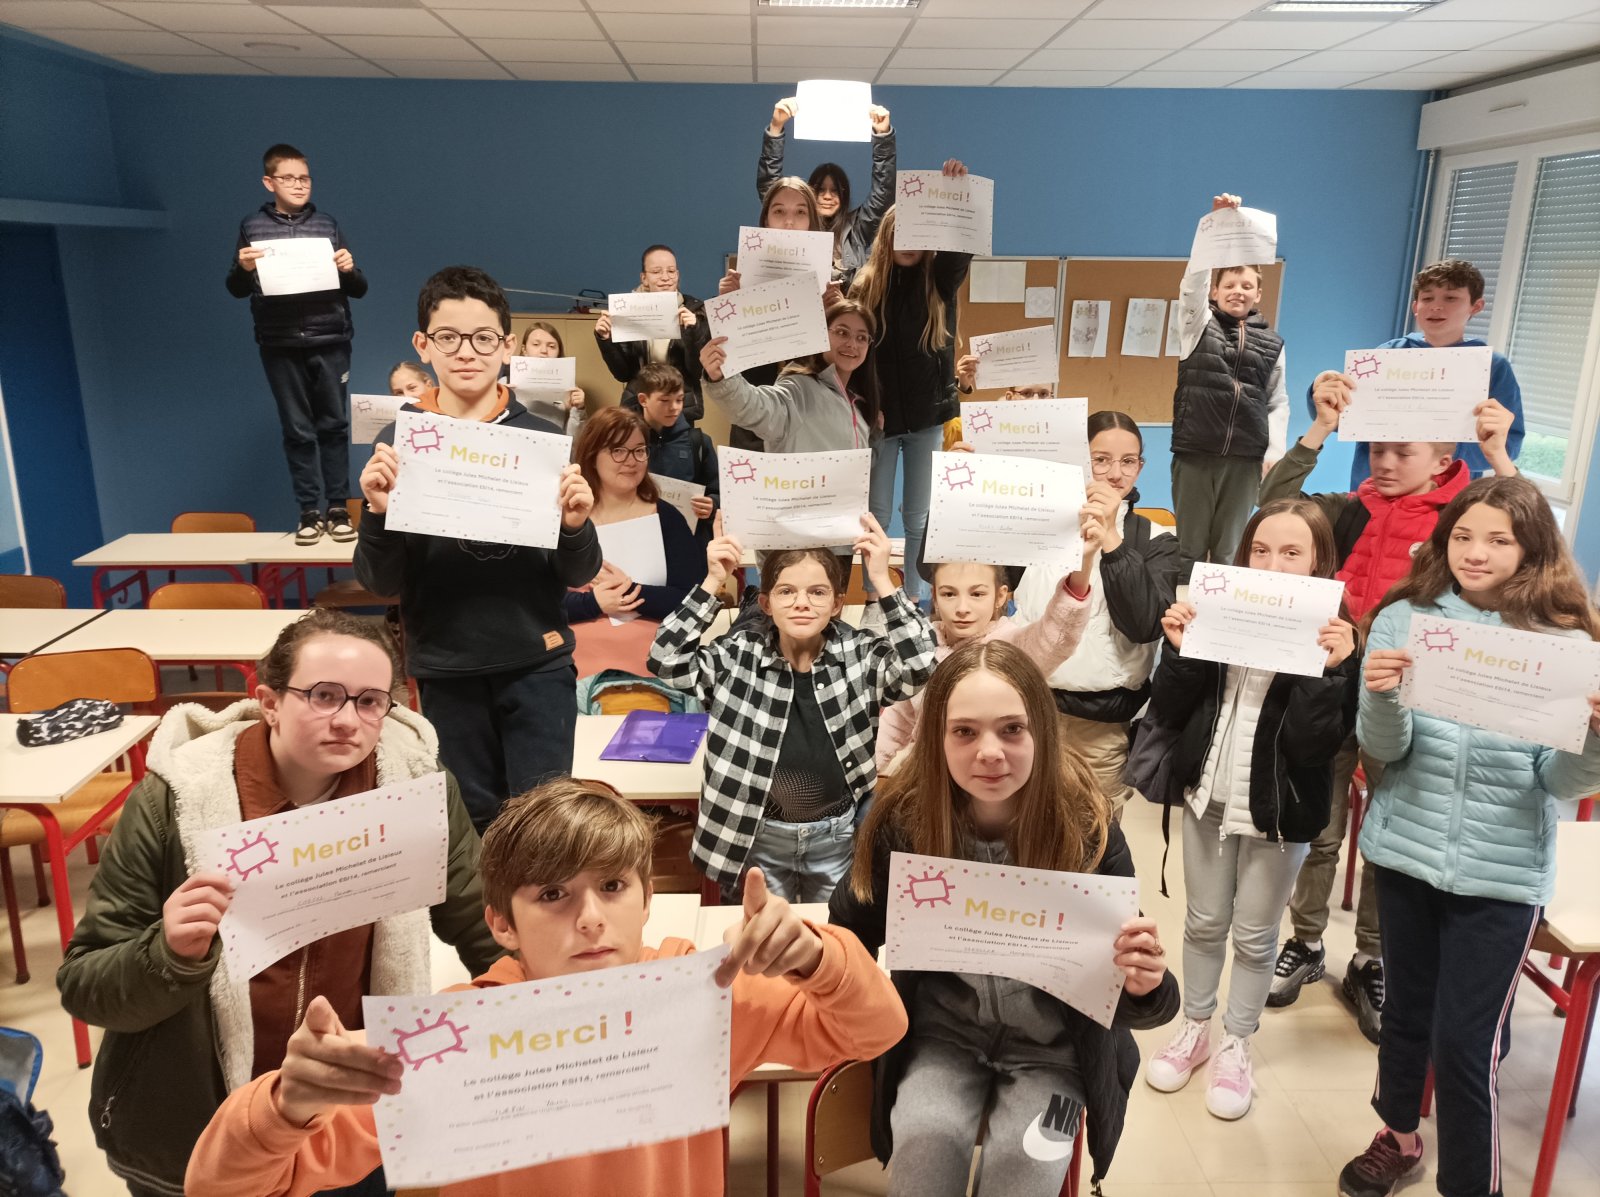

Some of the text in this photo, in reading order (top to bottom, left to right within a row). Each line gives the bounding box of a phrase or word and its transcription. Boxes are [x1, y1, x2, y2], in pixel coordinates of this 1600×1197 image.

[928, 187, 962, 201] Merci
[766, 244, 798, 256] Merci
[742, 298, 790, 318] Merci !
[996, 343, 1024, 354] Merci
[1386, 368, 1445, 380] Merci !
[999, 422, 1049, 434] Merci !
[450, 445, 519, 470] Merci !
[764, 475, 826, 490] Merci !
[982, 479, 1044, 497] Merci !
[1233, 588, 1294, 609] Merci !
[1464, 647, 1542, 676] Merci !
[292, 824, 385, 867] Merci !
[315, 869, 333, 879] Jules
[335, 859, 366, 873] Michelet
[378, 849, 402, 860] Lisieux
[361, 862, 396, 876] remercient
[964, 898, 1064, 931] Merci !
[489, 1011, 632, 1059] Merci !
